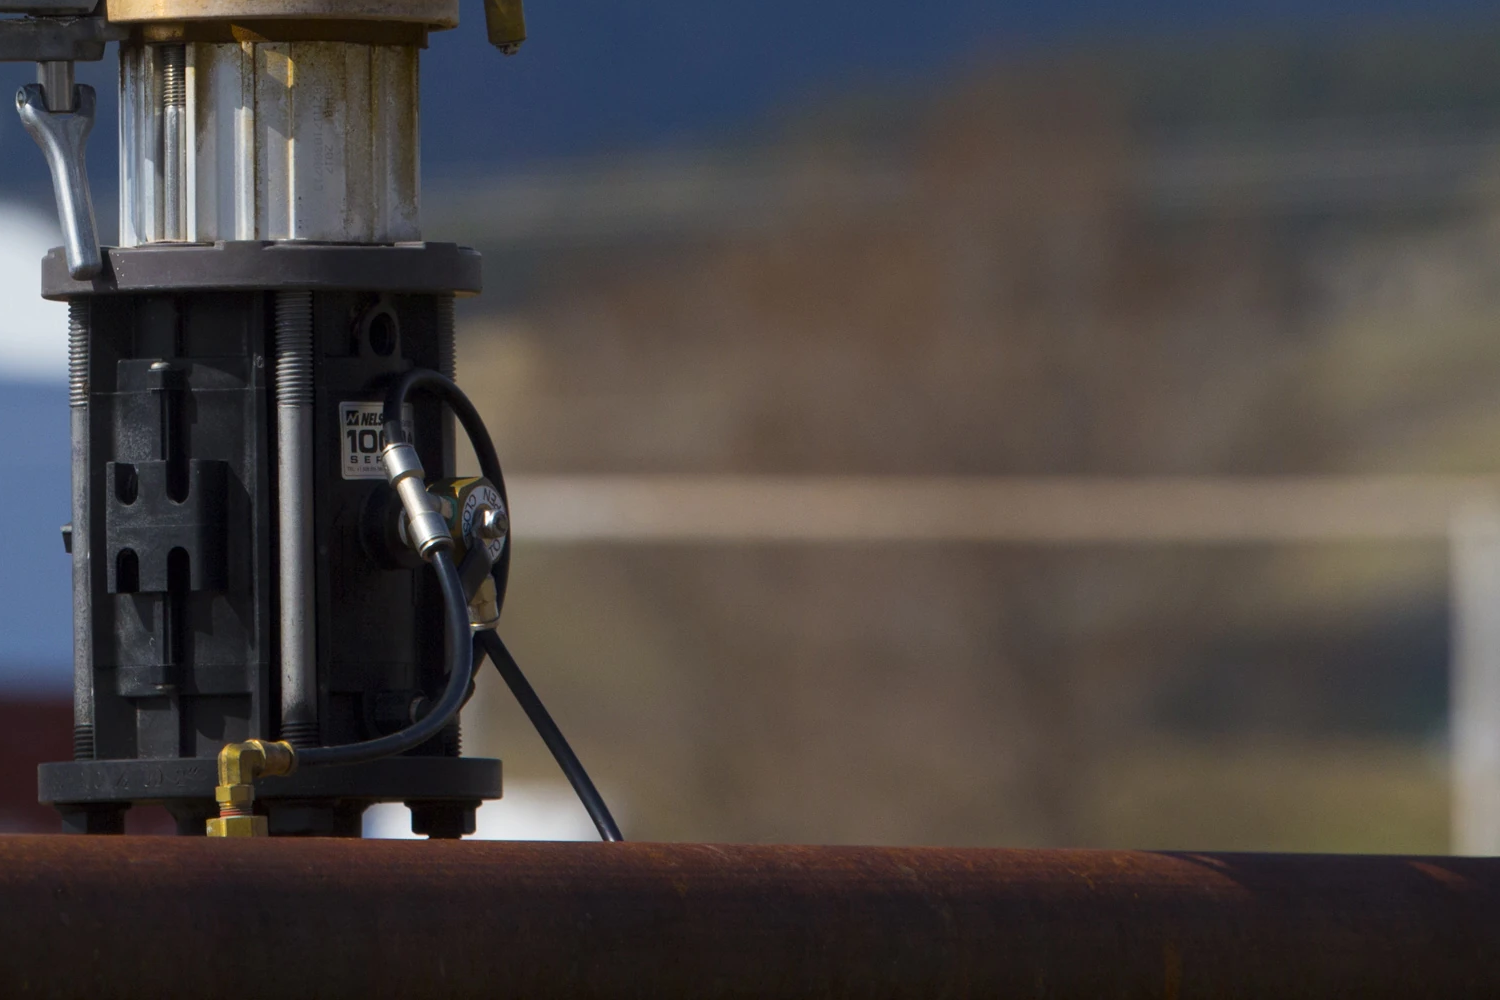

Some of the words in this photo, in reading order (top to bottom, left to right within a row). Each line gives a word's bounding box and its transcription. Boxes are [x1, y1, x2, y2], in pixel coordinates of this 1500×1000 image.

[361, 412, 384, 426] NELS
[350, 455, 382, 464] SER
[483, 488, 502, 510] PEN
[463, 494, 477, 534] CLOS
